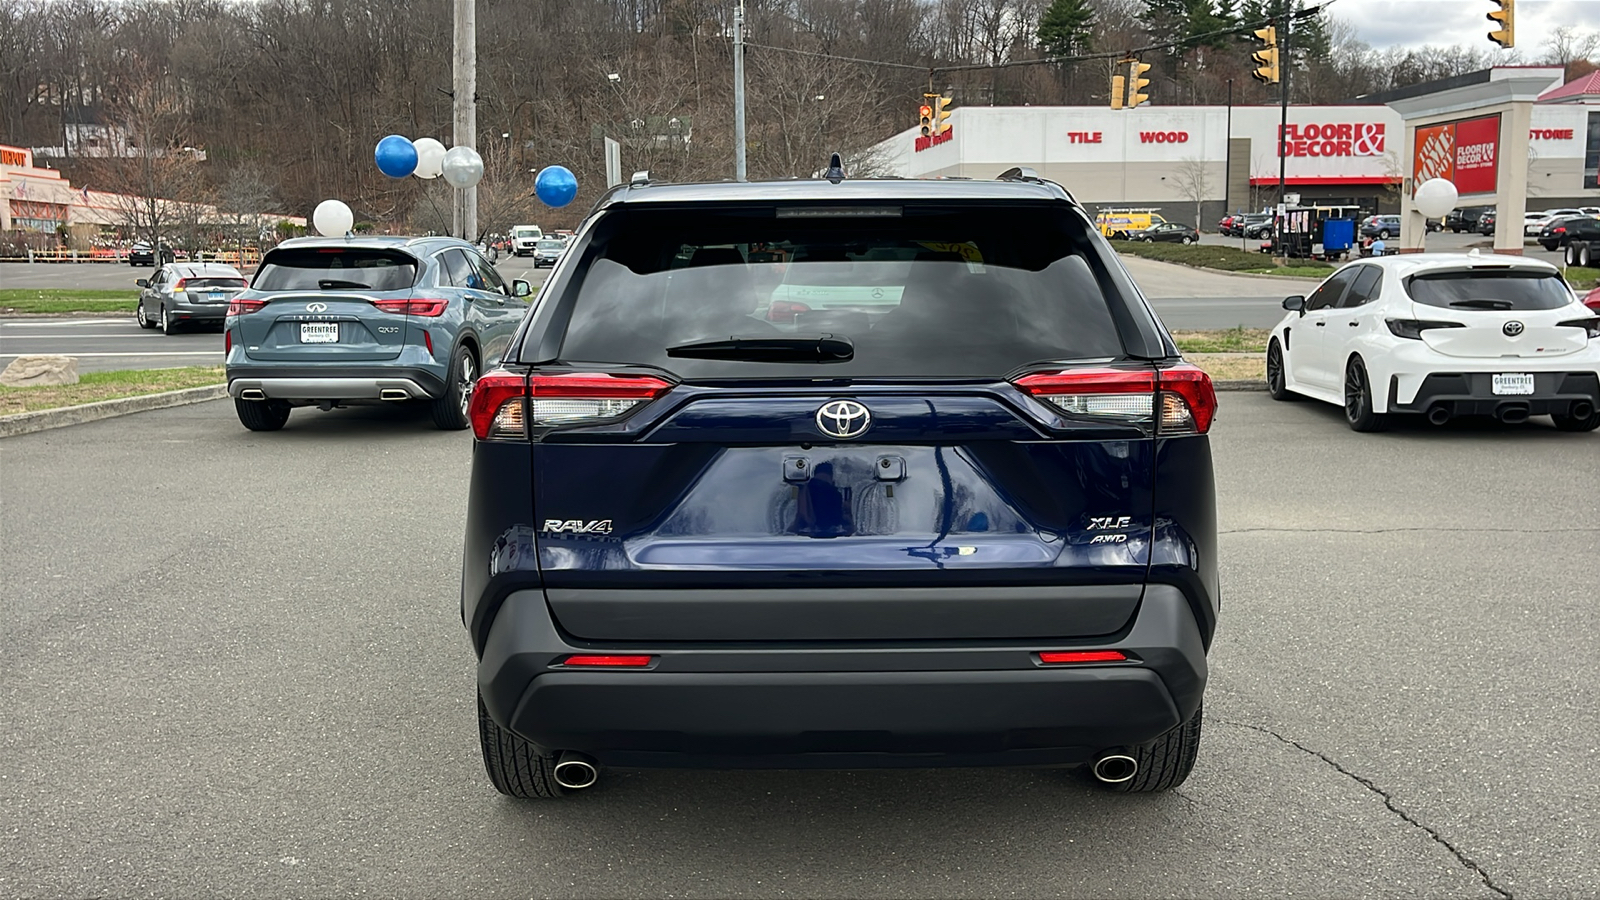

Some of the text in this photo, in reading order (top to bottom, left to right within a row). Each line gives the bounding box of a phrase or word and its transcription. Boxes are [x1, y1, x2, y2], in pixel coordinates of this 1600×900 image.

[1067, 132, 1102, 144] TILE
[1139, 131, 1189, 144] WOOD
[1277, 123, 1353, 140] FLOOR
[1277, 140, 1353, 157] DECOR
[1418, 132, 1436, 163] THE
[1457, 144, 1482, 156] FLOOR
[1456, 153, 1482, 165] DECOR
[542, 519, 613, 534] RAV4
[1086, 516, 1131, 530] XLE
[1090, 534, 1127, 544] AWD
